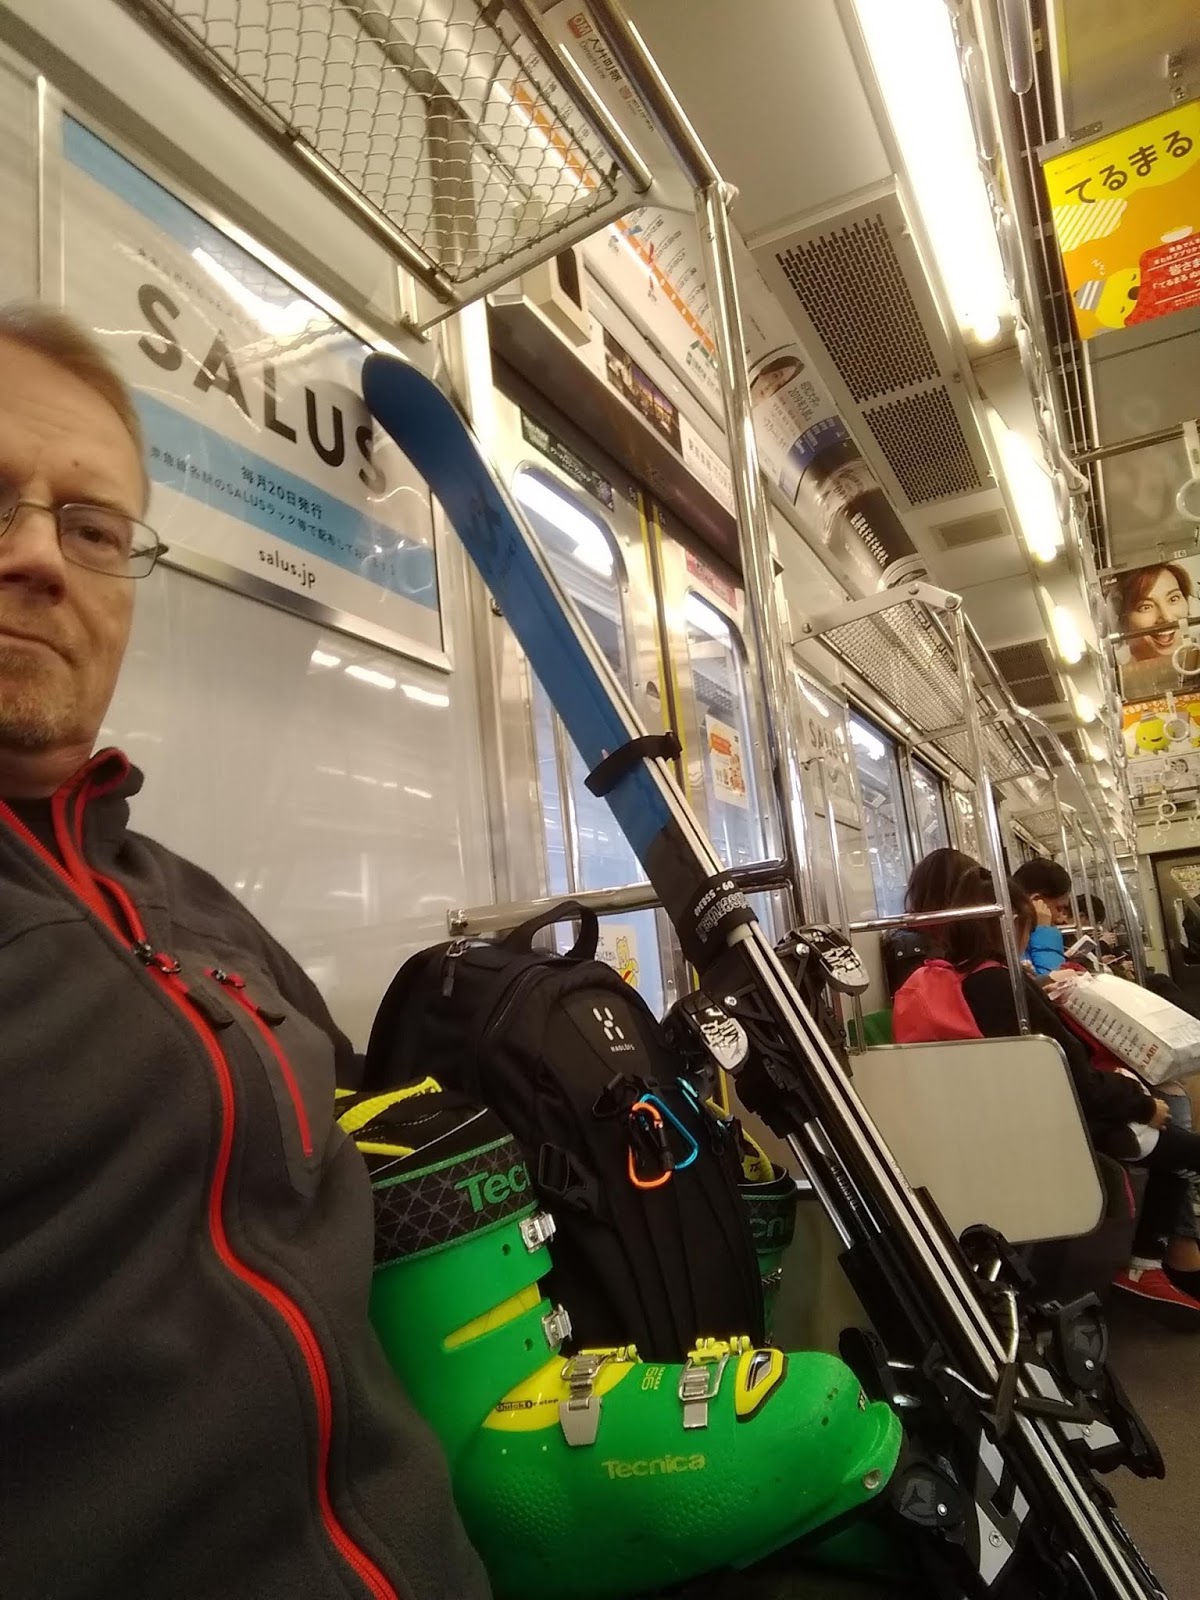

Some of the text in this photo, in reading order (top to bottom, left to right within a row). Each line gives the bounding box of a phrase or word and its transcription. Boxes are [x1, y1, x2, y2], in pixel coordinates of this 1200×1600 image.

[1065, 130, 1194, 204] てるまる
[137, 284, 387, 496] SALUS
[240, 464, 324, 520] 毎月20日発行
[258, 546, 317, 590] salus.jp
[454, 1160, 528, 1213] Tec
[602, 1453, 706, 1480] Tecnica
